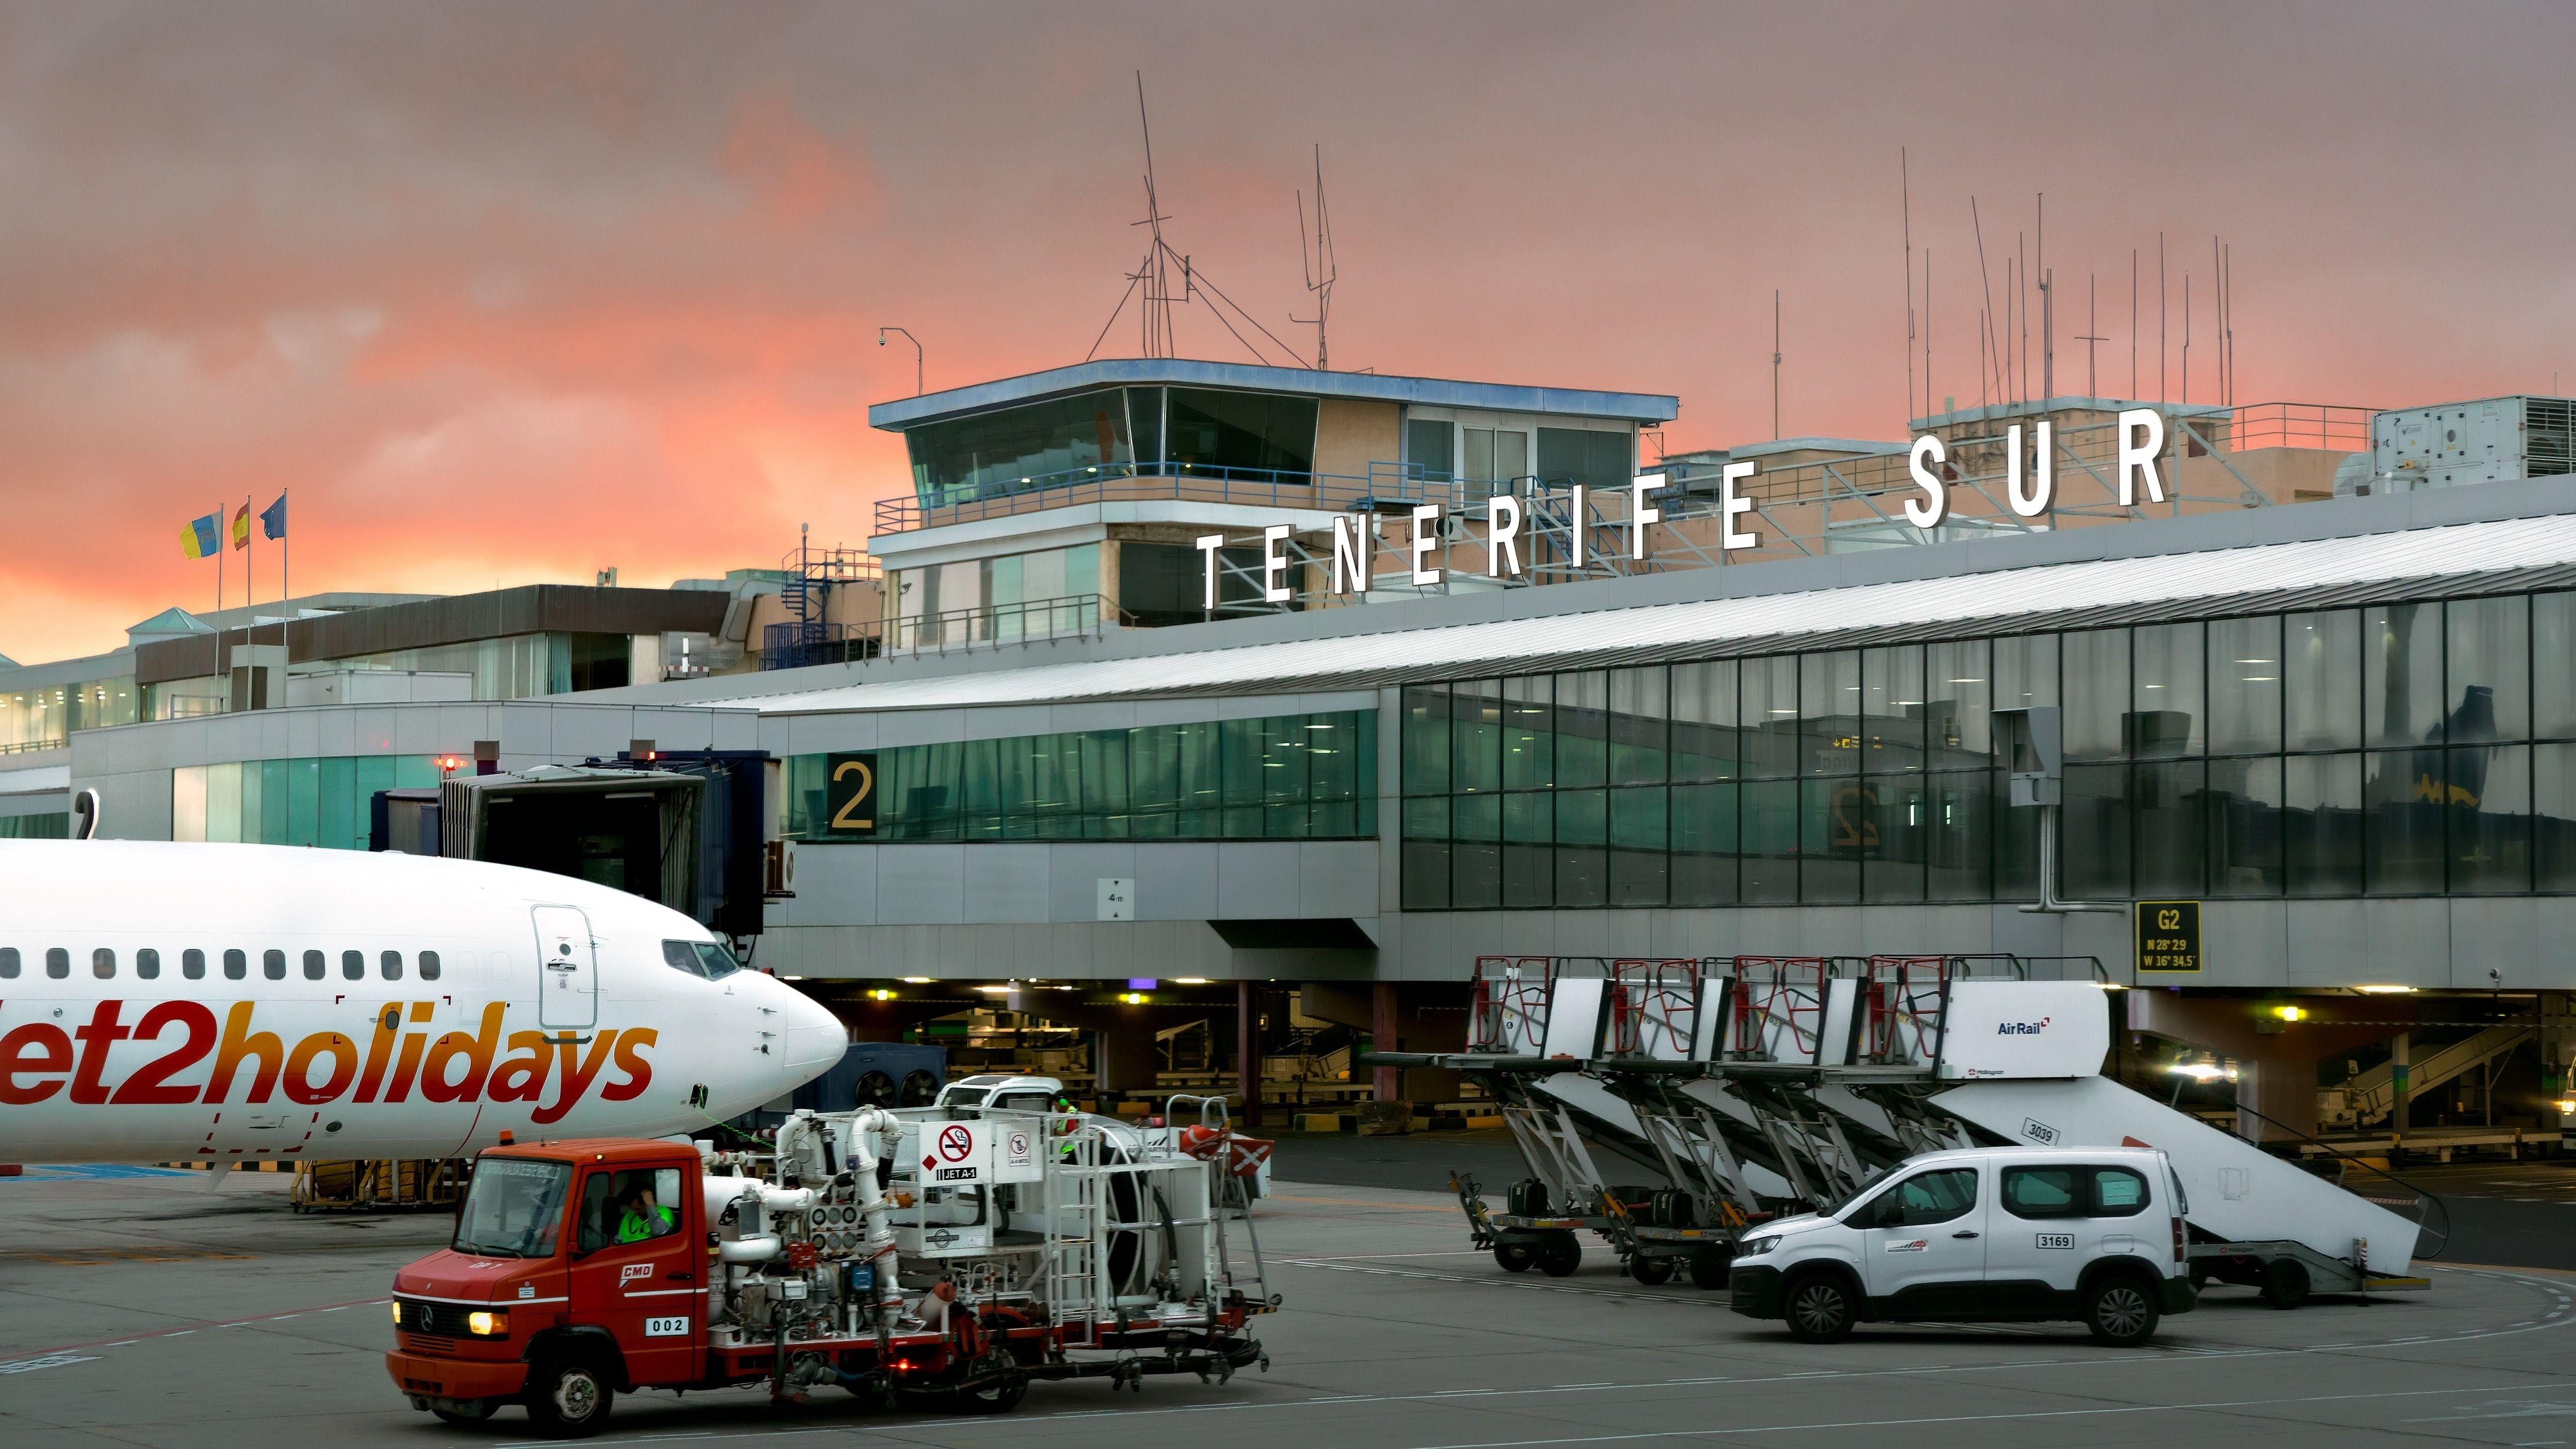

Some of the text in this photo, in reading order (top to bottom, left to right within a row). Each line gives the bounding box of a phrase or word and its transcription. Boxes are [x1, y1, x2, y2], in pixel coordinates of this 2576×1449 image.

[1197, 408, 2172, 610] TENERIFE SUR
[832, 761, 872, 828] 2
[2158, 909, 2180, 929] G2
[2147, 939, 2155, 950] N
[2143, 956, 2153, 966] W
[0, 999, 659, 1124] et2holidays
[2029, 1124, 2052, 1141] 3039
[946, 1168, 975, 1179] JET A-1
[2041, 1236, 2069, 1246] 3169
[624, 1266, 650, 1277] CMD
[653, 1320, 682, 1332] 002
